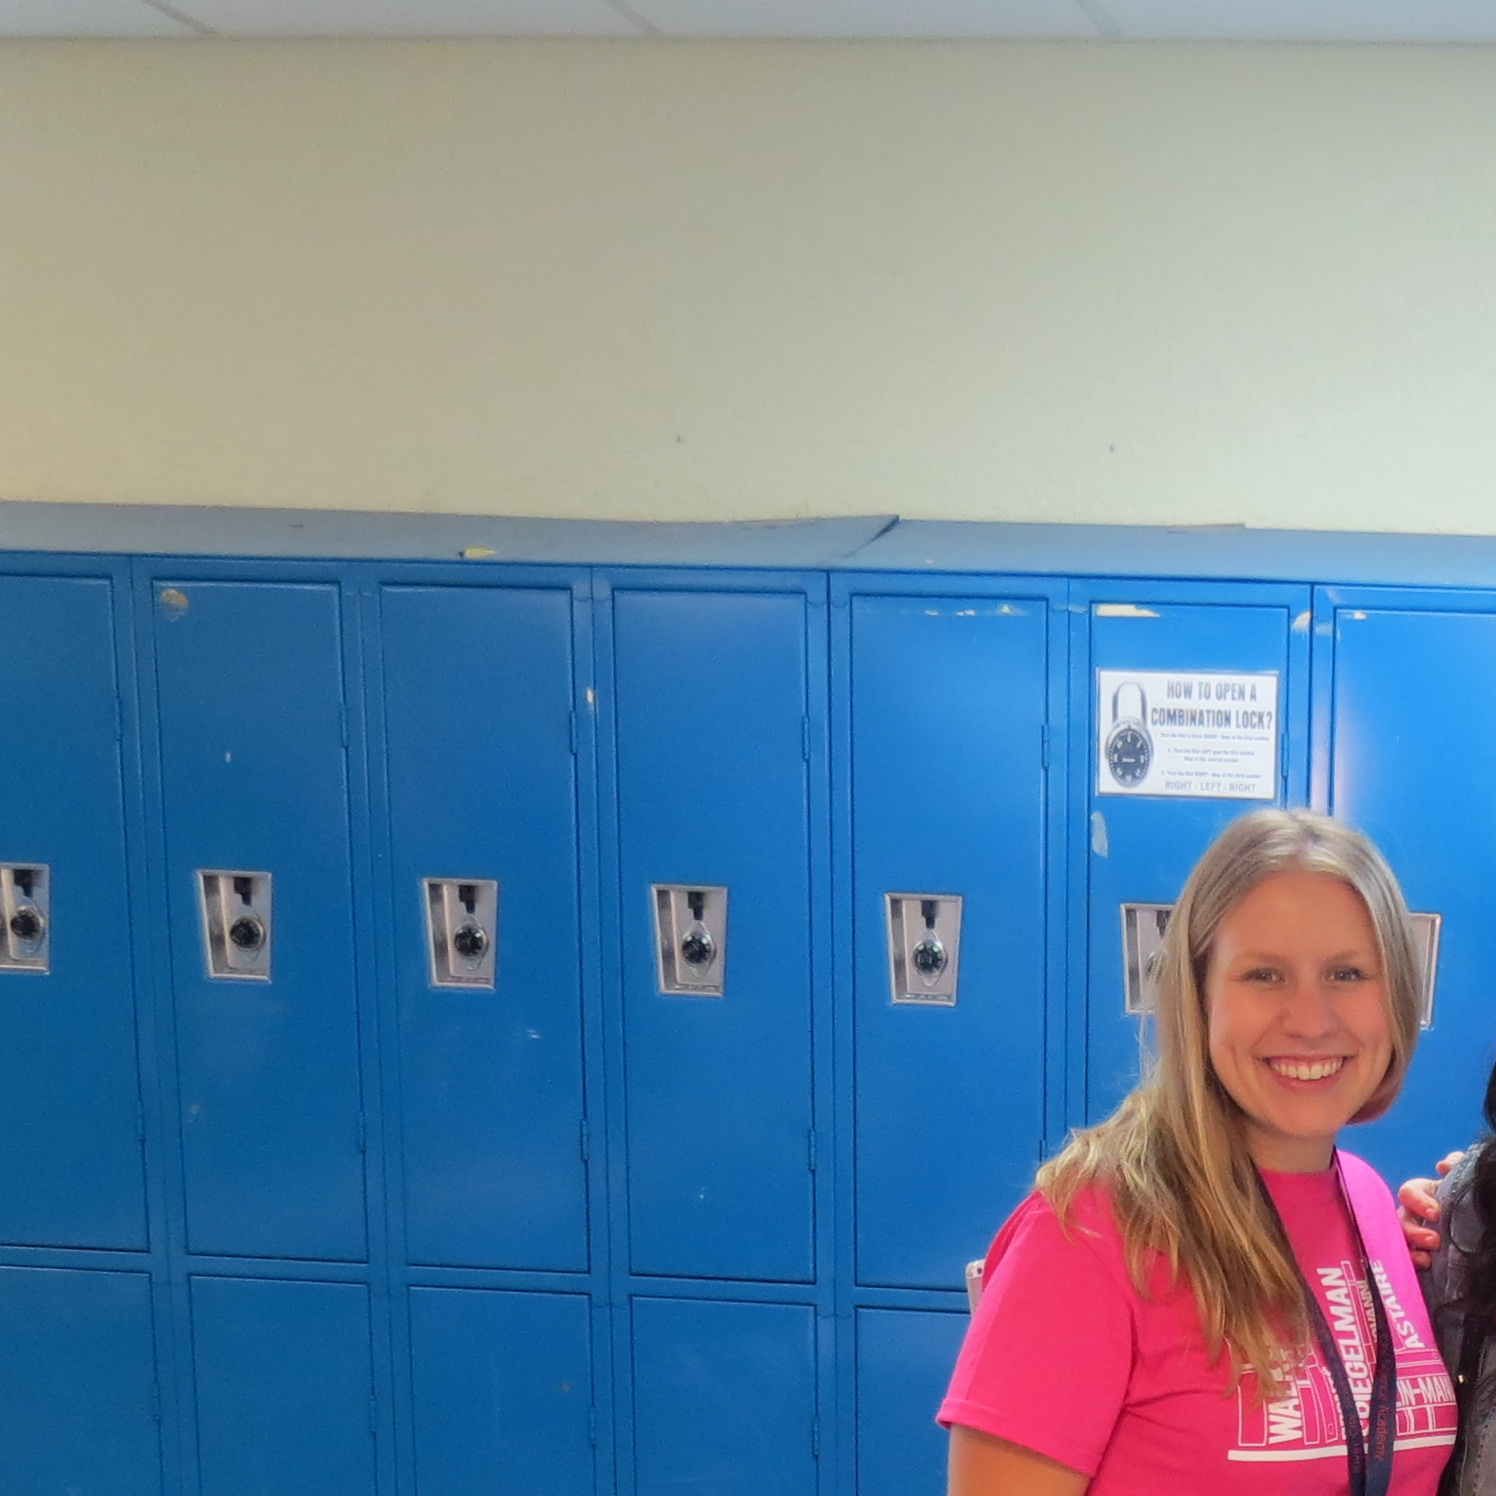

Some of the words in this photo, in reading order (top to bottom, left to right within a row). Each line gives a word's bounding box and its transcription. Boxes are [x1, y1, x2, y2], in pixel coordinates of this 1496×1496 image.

[1167, 681, 1193, 699] HOW
[1198, 682, 1211, 700] TO
[1216, 682, 1245, 701] OPEN
[1250, 684, 1257, 702] A
[1151, 707, 1231, 728] COMBINATION
[1236, 710, 1273, 730] LOCK?
[1165, 781, 1192, 790] RIGHT
[1200, 782, 1221, 791] LEFT
[1229, 783, 1256, 792] RIGHT
[1371, 1260, 1425, 1348] ASTAIRE
